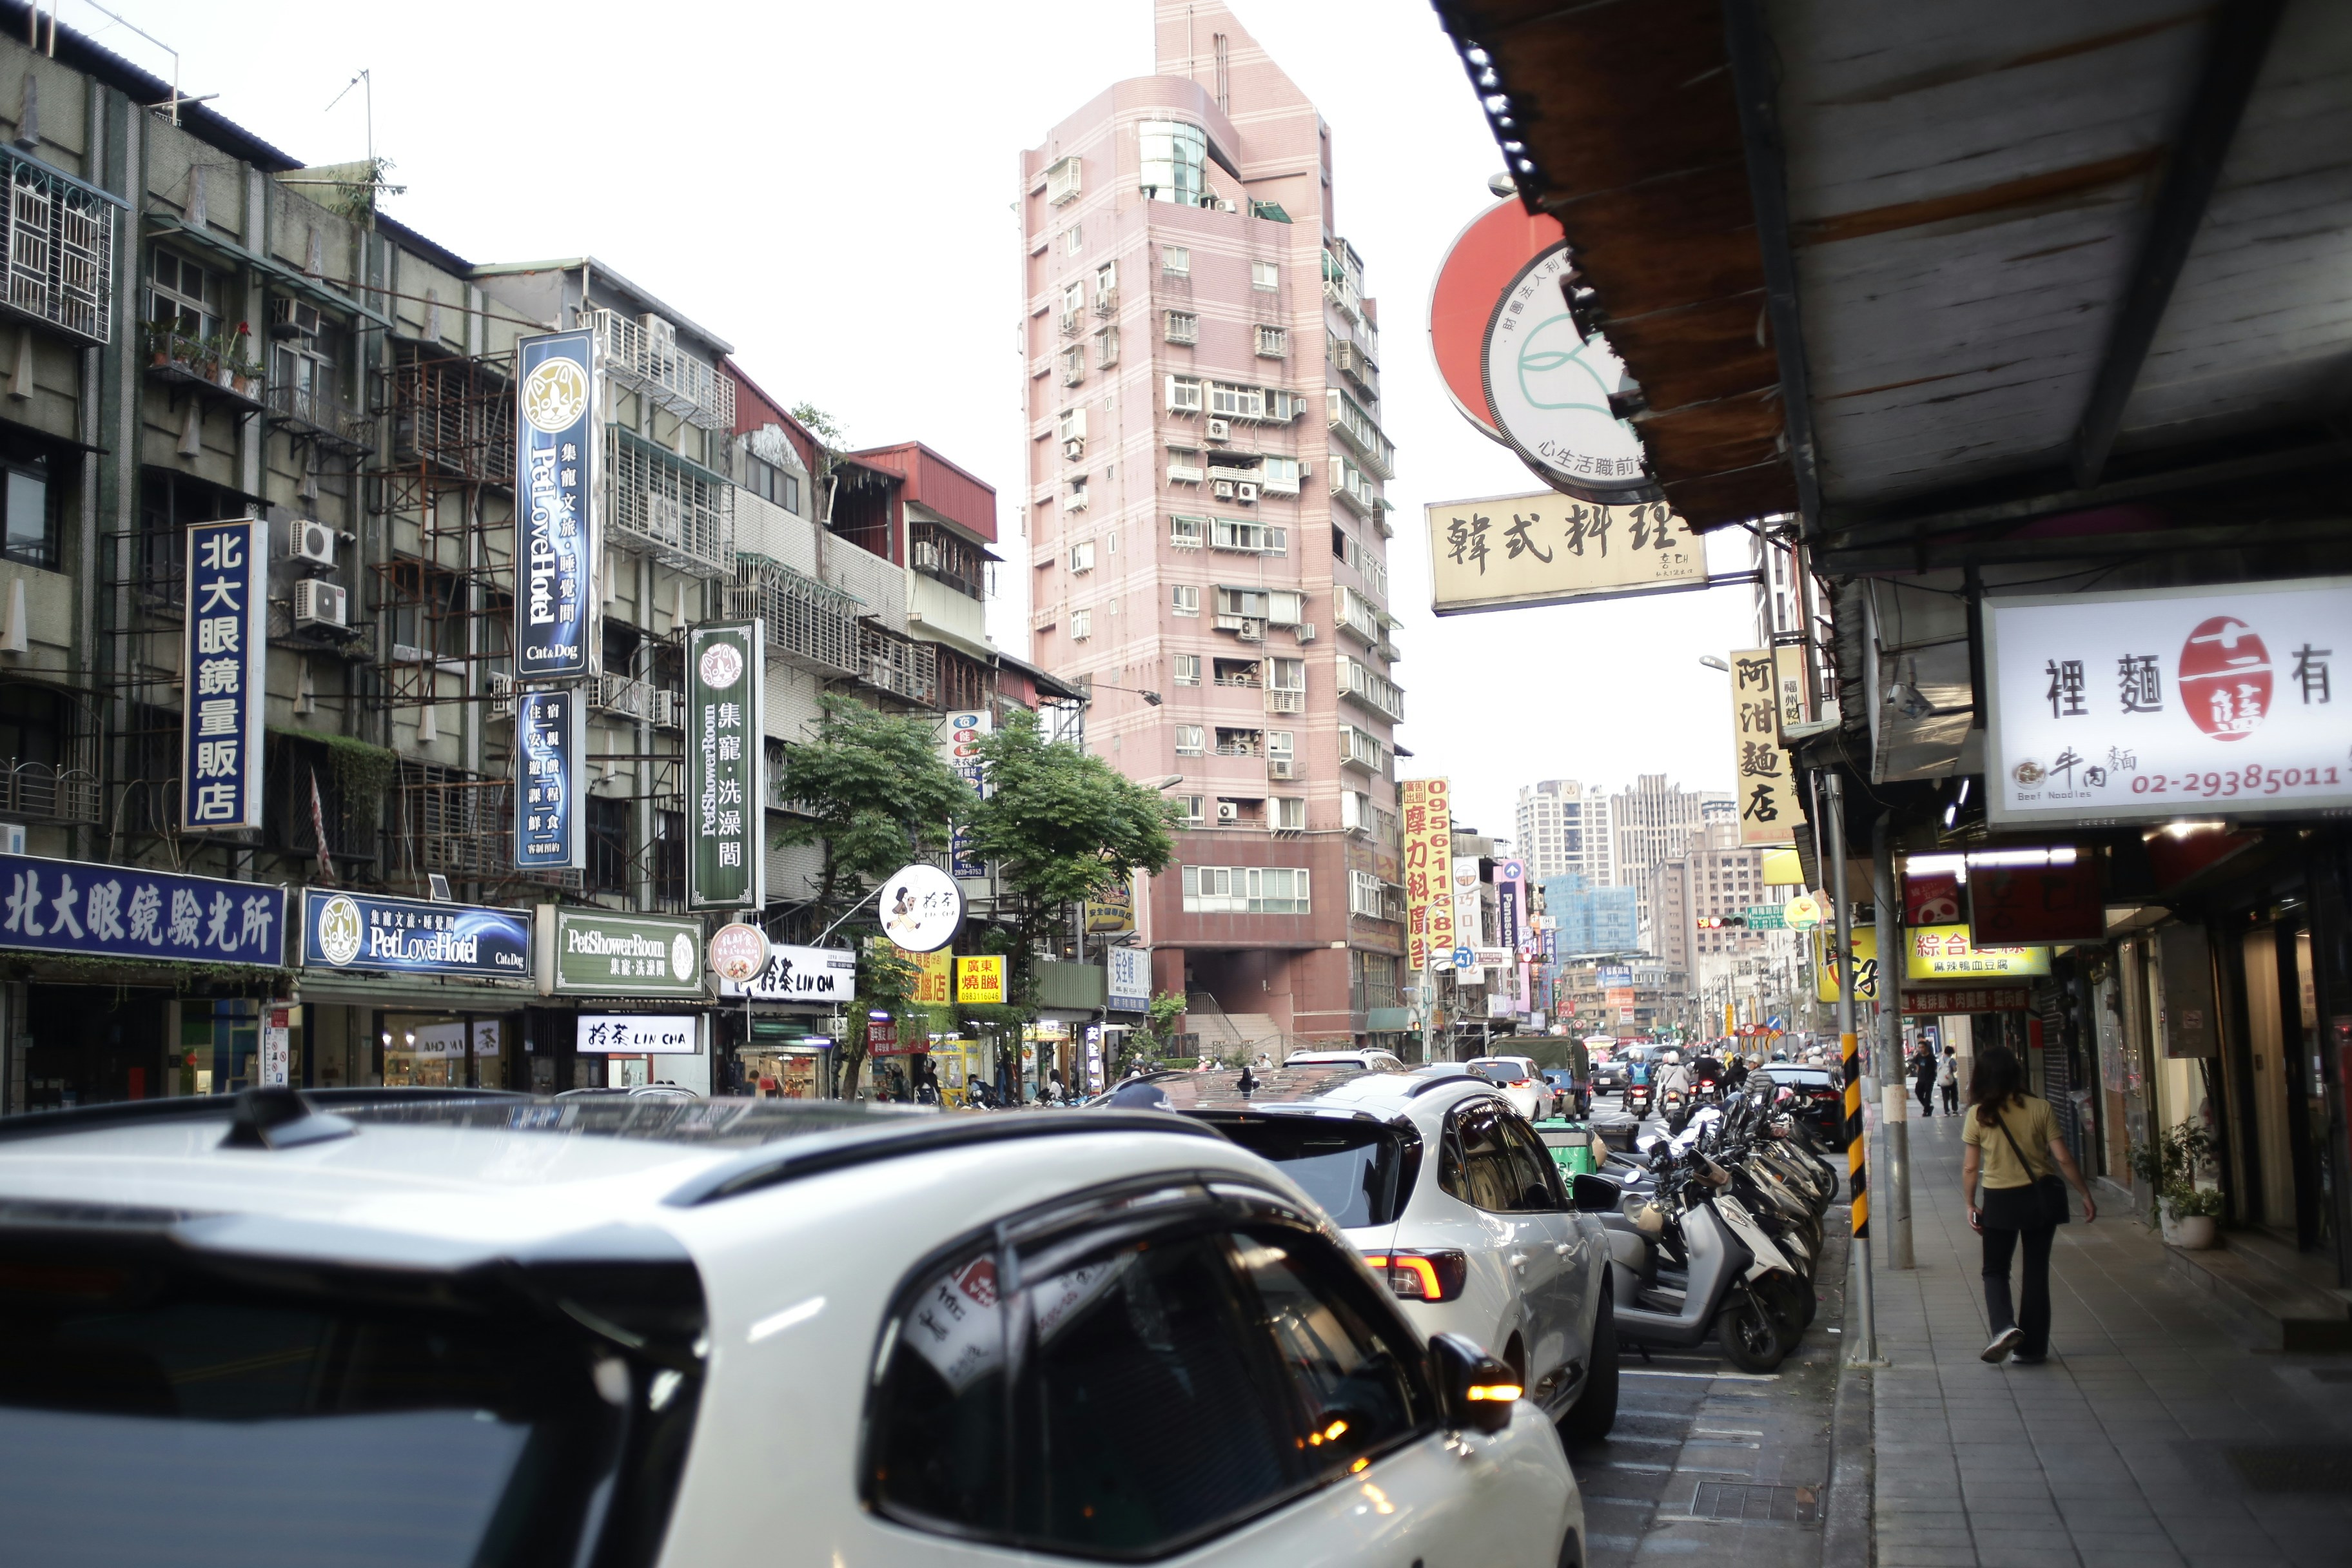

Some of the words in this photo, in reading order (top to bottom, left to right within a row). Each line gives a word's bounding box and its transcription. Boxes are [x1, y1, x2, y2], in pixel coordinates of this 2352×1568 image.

[530, 444, 557, 627] PetLoveHotel
[1447, 503, 1676, 576] 韓式料理
[195, 533, 241, 821] 北大眼鏡量販店
[529, 704, 560, 720] 住宿
[528, 731, 560, 747] 安親
[1735, 658, 1783, 822] 阿泔麵店
[701, 703, 716, 838] PetShowerRoom
[2049, 745, 2137, 790] 牛肉麵
[2132, 763, 2341, 797] 02-29385011
[528, 787, 560, 803] 課程
[2017, 792, 2041, 801] Beef
[2048, 790, 2092, 799] Noodles
[528, 814, 560, 831] 鮮食
[5, 869, 273, 954] 北大眼鏡驗光所
[1503, 893, 1514, 948] Panasoni
[369, 926, 478, 964] PetLoveHotel
[567, 928, 665, 958] PetShowerRoom
[1916, 933, 2026, 957] 綜合
[967, 960, 993, 972] 廣東
[1934, 959, 2009, 972] 麻辣鴨血豆腐
[796, 974, 814, 992] LIN
[817, 975, 835, 992] CHA
[961, 974, 999, 990] 燒臘
[634, 1034, 656, 1044] LIN
[662, 1033, 685, 1044] CHA
